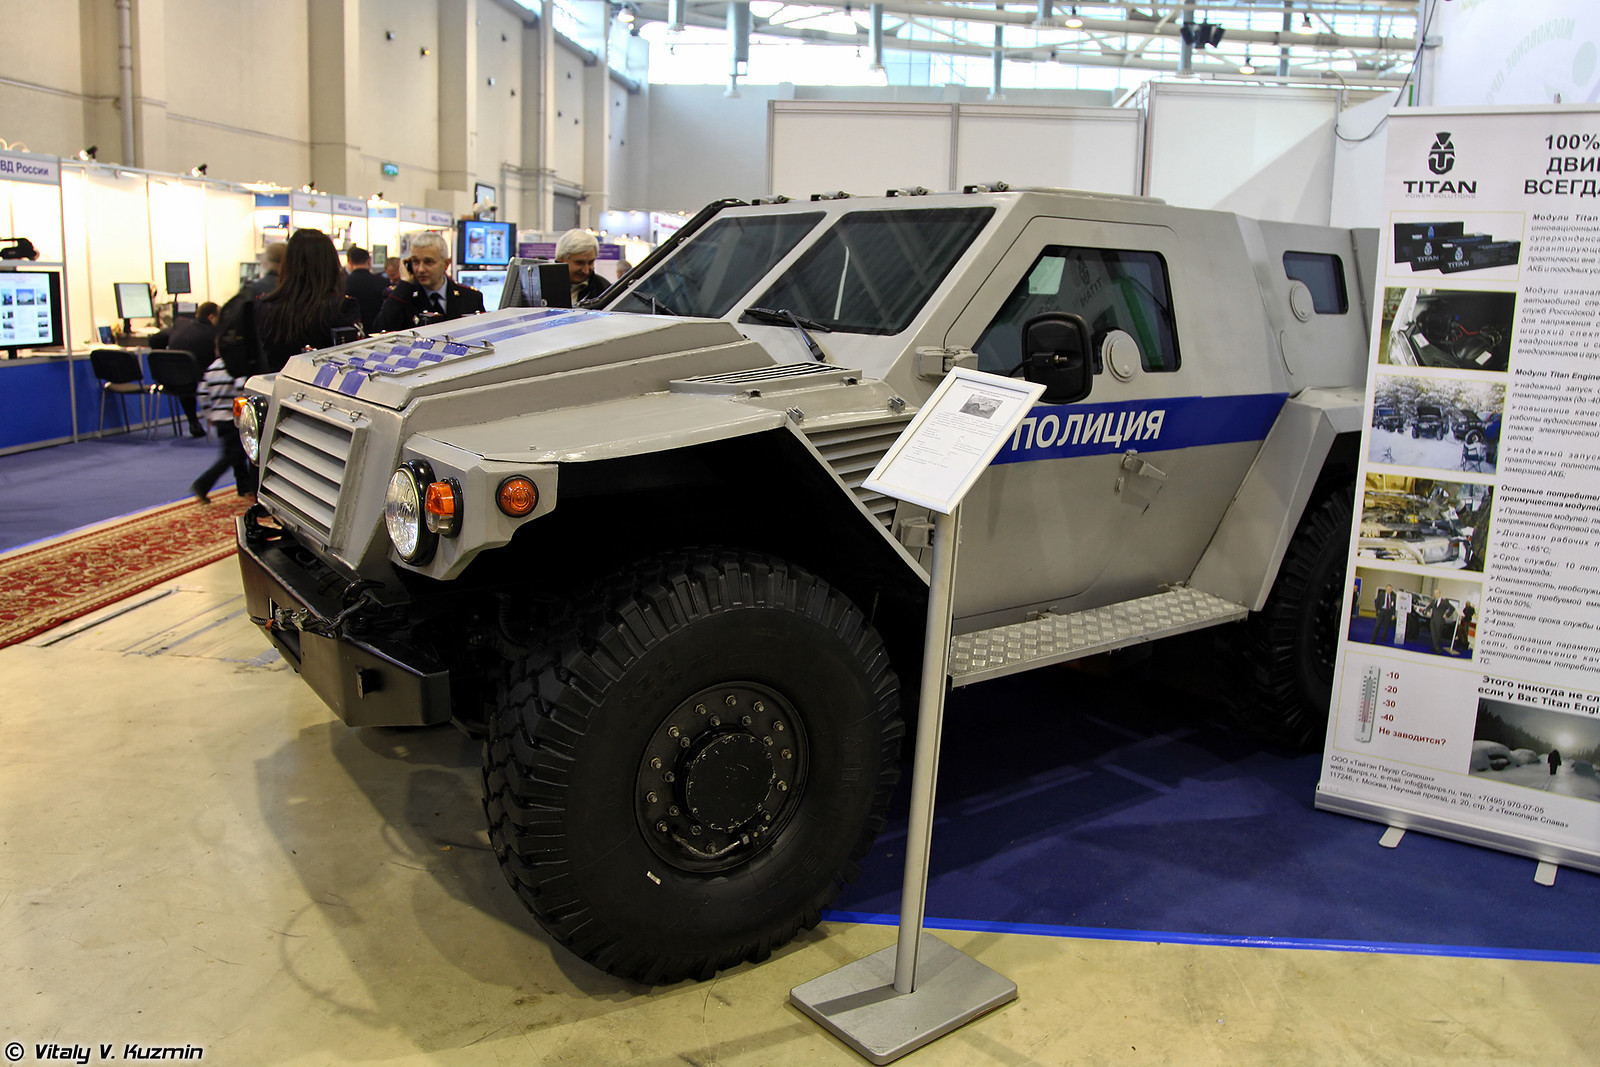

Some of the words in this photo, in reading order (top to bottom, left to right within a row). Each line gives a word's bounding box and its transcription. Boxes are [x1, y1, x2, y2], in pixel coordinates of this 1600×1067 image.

[1545, 134, 1600, 150] 100%
[16, 162, 49, 176] России
[1403, 180, 1476, 193] TITAN
[1524, 179, 1600, 198] ВСЕГД
[1532, 213, 1569, 222] Модули
[1575, 214, 1598, 222] Titan
[1448, 260, 1470, 268] TITAN
[1524, 286, 1558, 295] Модули
[1524, 298, 1580, 306] автомобилей
[1522, 307, 1547, 316] служб
[1548, 307, 1596, 317] Российской
[1540, 319, 1591, 328] напряжения
[1520, 328, 1564, 336] широкий
[1518, 338, 1578, 346] квадроциклов
[1518, 348, 1578, 357] внедорожников
[1514, 368, 1547, 378] Модули
[1550, 370, 1570, 379] Titan
[1512, 391, 1572, 402] температурах
[1518, 405, 1570, 414] повышение
[1011, 410, 1166, 450] ПОЛИЦИЯ
[1508, 423, 1534, 432] также
[1504, 456, 1556, 467] практически
[1501, 484, 1544, 495] Основные
[1500, 494, 1564, 508] преимущества
[1504, 506, 1553, 518] Применение
[1496, 517, 1548, 528] напряжением
[1550, 522, 1590, 534] бортовой
[1502, 529, 1546, 540] Диапазон
[1550, 536, 1590, 546] рабочих
[1500, 553, 1520, 562] Срок
[1566, 561, 1576, 569] 10
[1494, 586, 1532, 598] Снижение
[1536, 594, 1582, 606] требуемой
[1492, 608, 1536, 621] Увеличение
[1538, 617, 1560, 626] срока
[1563, 620, 1594, 630] службы
[1490, 630, 1552, 646] Стабилизация
[1514, 645, 1578, 660] обеспечение
[1386, 672, 1400, 680] -10
[1384, 686, 1398, 694] -20
[1482, 676, 1514, 688] Этого
[1518, 682, 1564, 697] никогда
[1568, 692, 1582, 700] не
[1478, 686, 1504, 697] если
[1508, 692, 1514, 700] у
[1518, 692, 1538, 703] Вас
[1542, 696, 1570, 709] Titan
[1382, 700, 1396, 708] -30
[1380, 714, 1394, 722] -40
[1378, 726, 1390, 736] Не
[1393, 731, 1446, 746] заводится?
[1332, 755, 1348, 764] ООО
[1378, 764, 1400, 776] Пауэр
